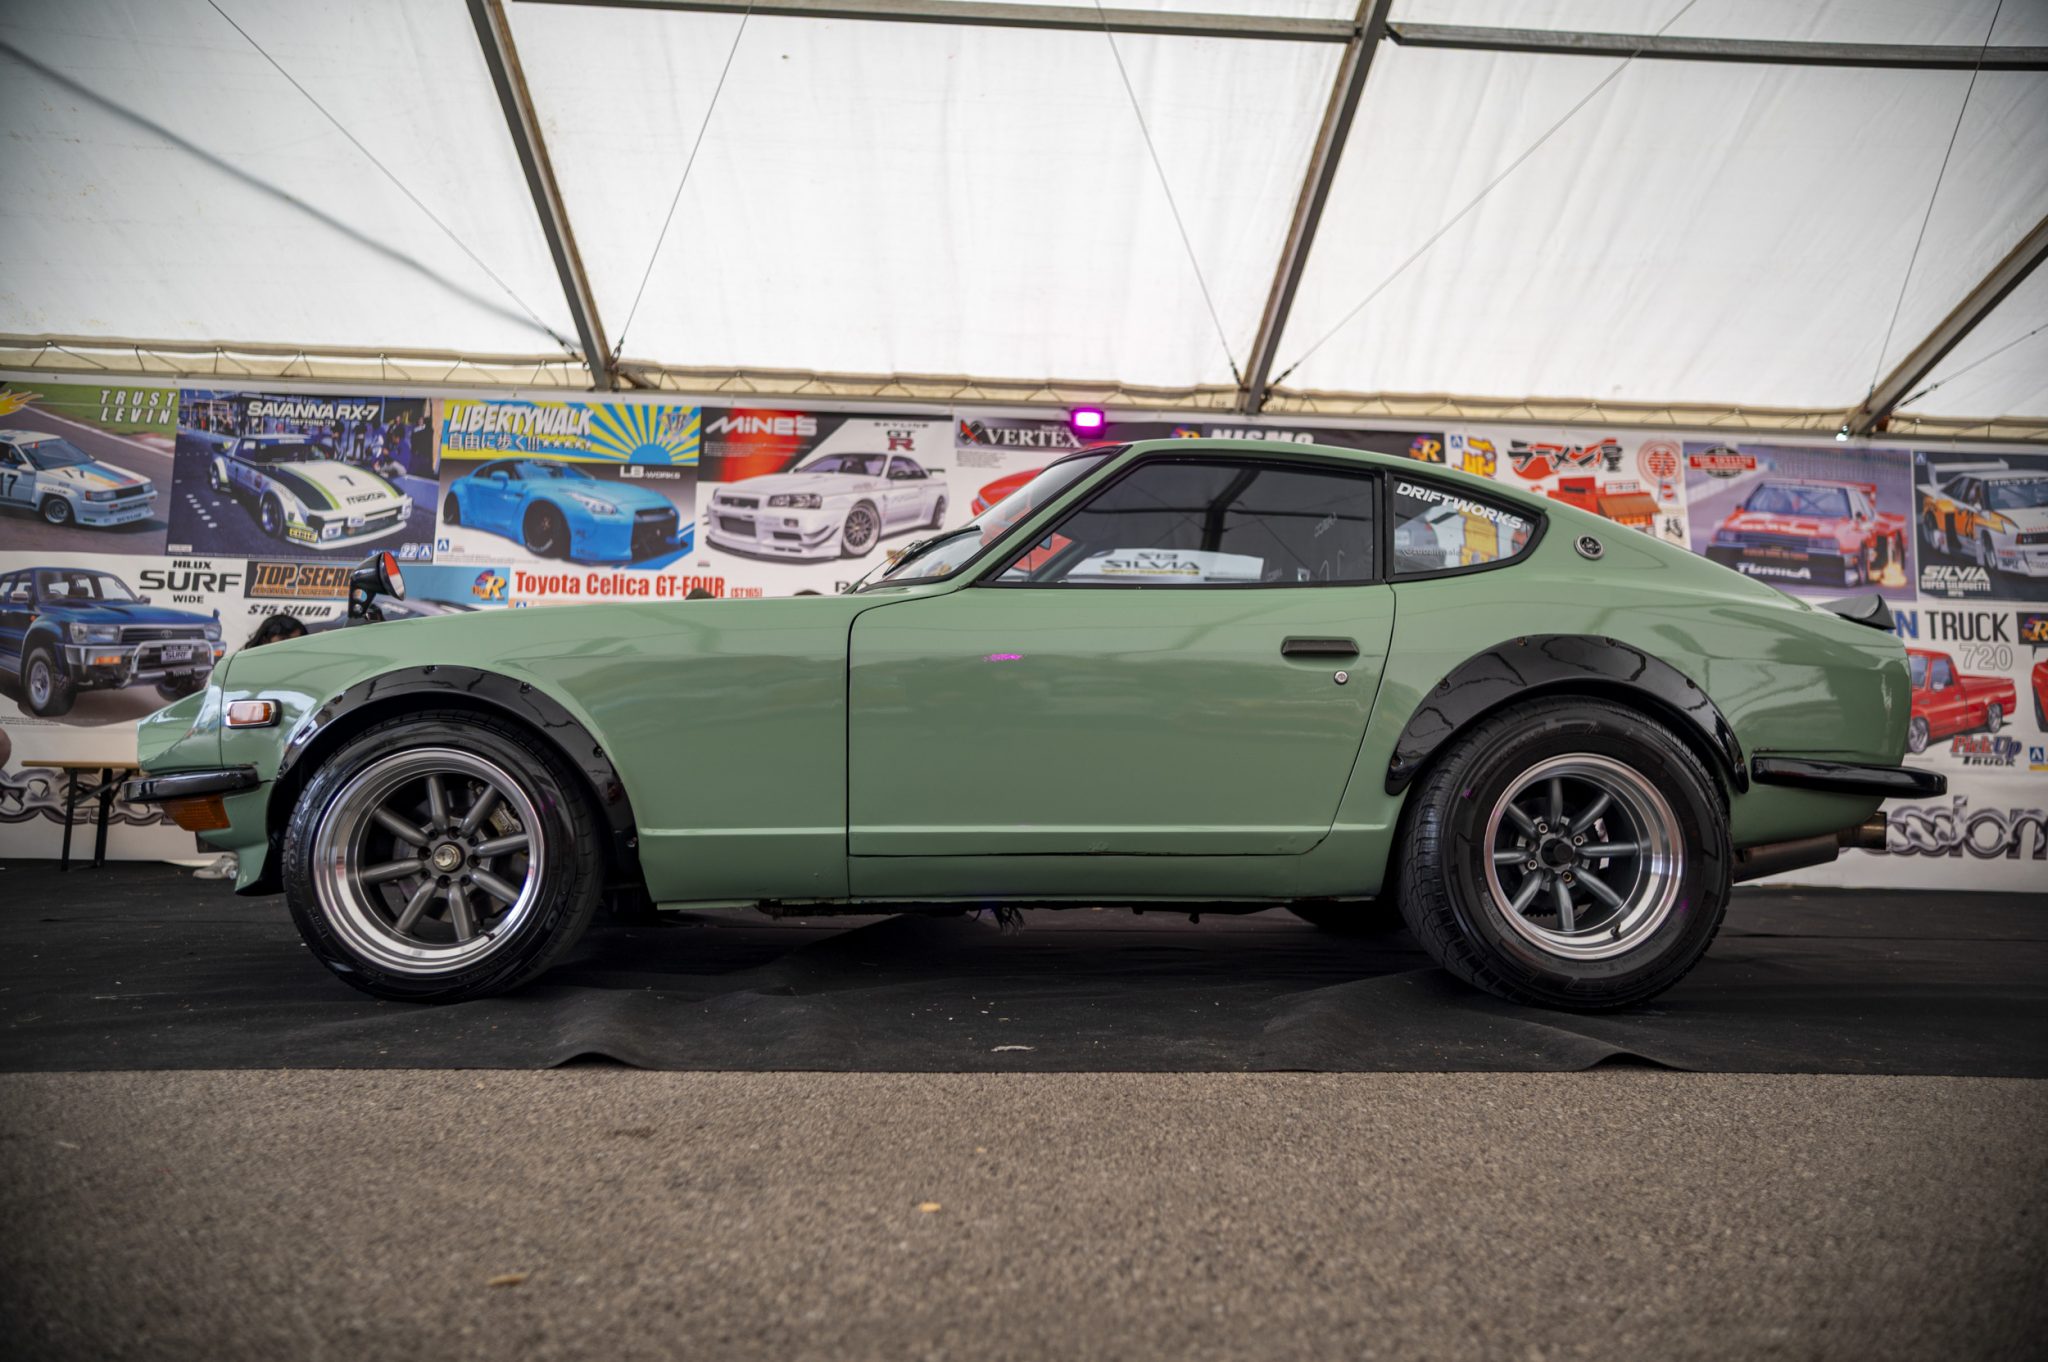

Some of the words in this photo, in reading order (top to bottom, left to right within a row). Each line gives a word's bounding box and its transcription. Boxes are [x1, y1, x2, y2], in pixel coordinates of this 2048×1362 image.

[100, 389, 177, 408] TRUST
[100, 407, 173, 424] LEVIN
[247, 401, 334, 419] SAVANNA
[335, 404, 379, 421] RX-7
[448, 404, 594, 436] LIBERTYWALK
[985, 428, 1082, 449] VERTEX
[1396, 482, 1525, 530] DRIFTWORKS
[172, 560, 212, 570] HILUX
[256, 564, 297, 586] TOP
[1923, 565, 1990, 581] SILVIA
[139, 570, 242, 593] SURF
[515, 571, 580, 595] Toyota
[586, 573, 649, 596] Celica
[655, 575, 725, 598] GT-FOUR
[172, 594, 204, 604] WIDE
[248, 604, 278, 615] S15
[280, 605, 332, 617] SILVIA
[1925, 611, 2011, 643] TRUCK
[1959, 643, 2013, 671] 720
[1885, 795, 2048, 861] ssion
